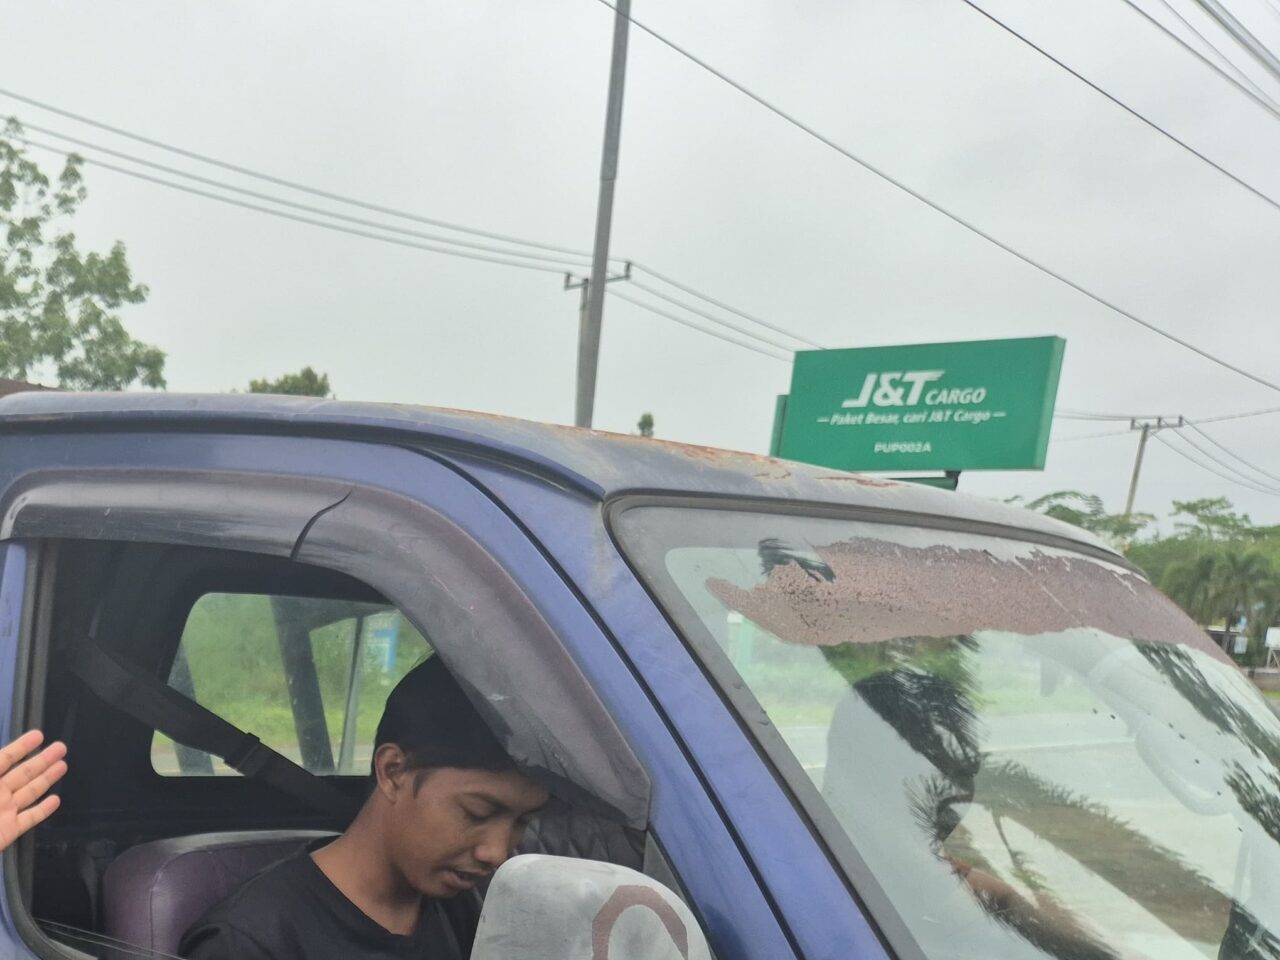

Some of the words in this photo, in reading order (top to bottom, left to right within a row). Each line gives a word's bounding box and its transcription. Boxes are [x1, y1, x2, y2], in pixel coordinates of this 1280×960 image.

[841, 369, 945, 408] J&T
[925, 387, 987, 405] CARGO
[830, 412, 864, 425] Paket
[903, 411, 927, 424] cari
[928, 410, 951, 423] J&T
[953, 409, 991, 424] Cargo
